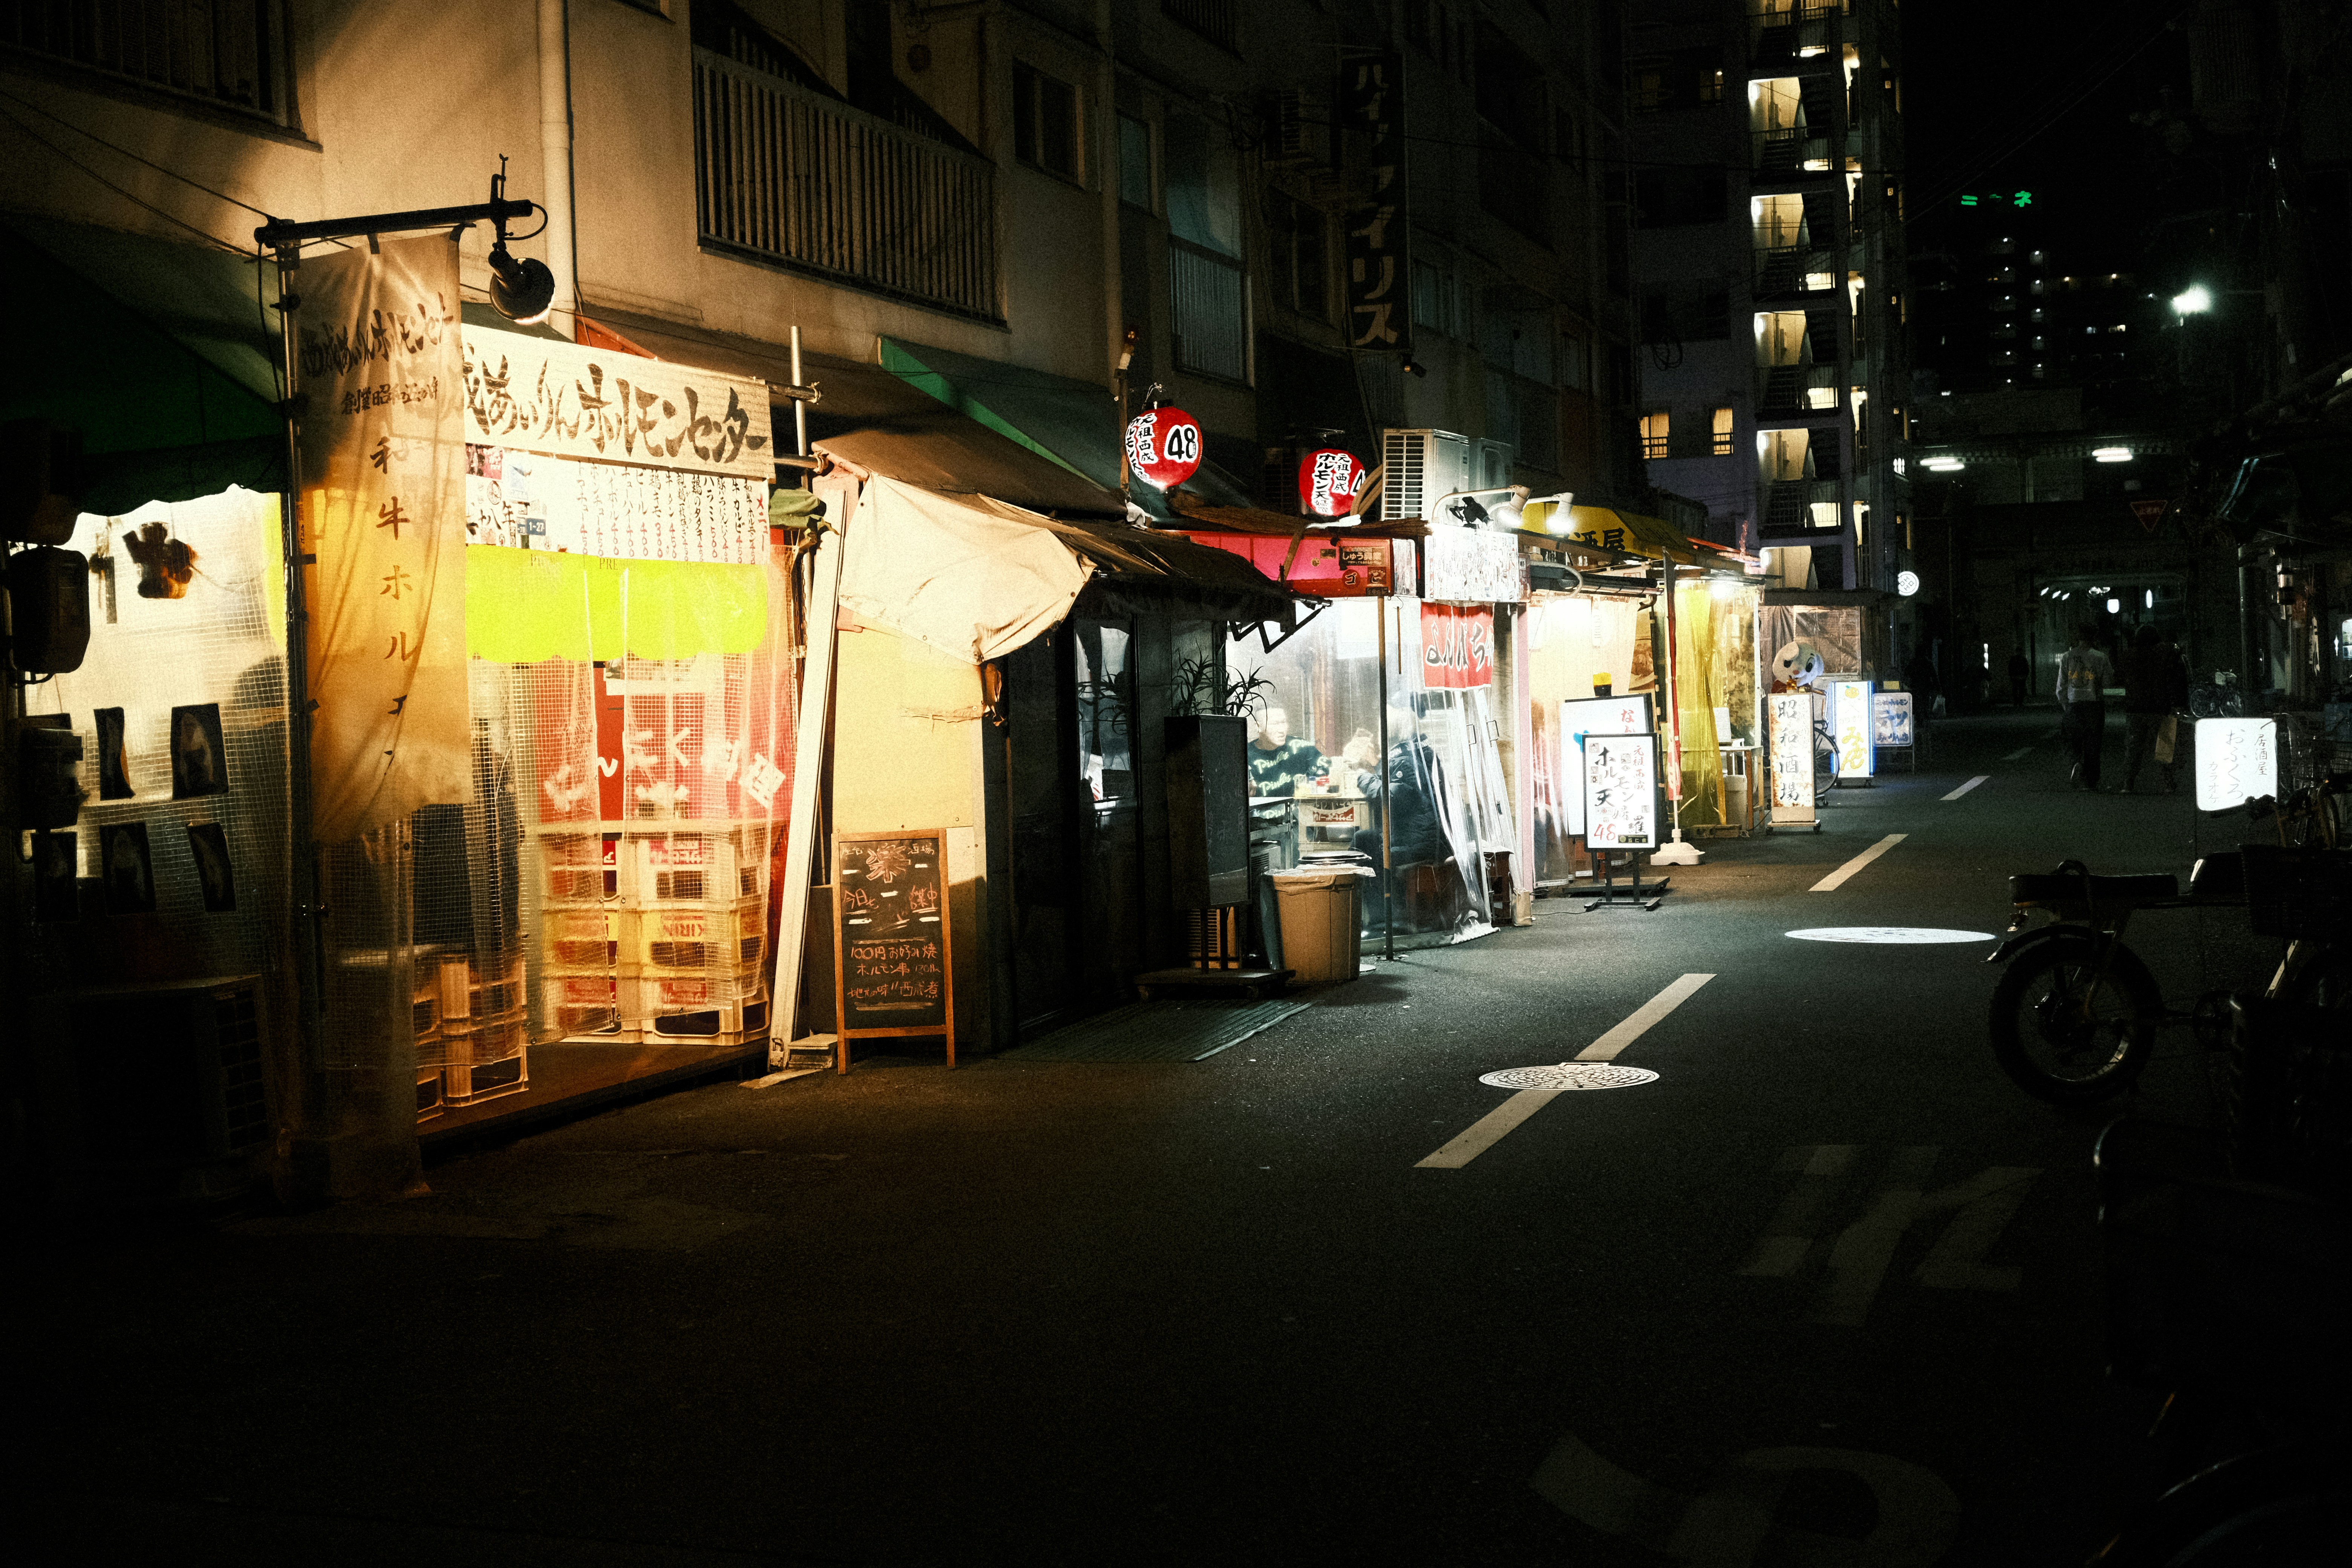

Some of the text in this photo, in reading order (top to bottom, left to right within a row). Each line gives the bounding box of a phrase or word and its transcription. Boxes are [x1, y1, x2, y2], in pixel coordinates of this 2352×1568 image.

[1138, 413, 1155, 461] 元祖西成
[1168, 427, 1197, 459] 48
[1334, 455, 1350, 492] 元祖西成
[576, 460, 589, 555] トマチュー 450
[606, 467, 619, 556] ハイボール 400
[622, 466, 635, 557] チューハイ 400
[636, 468, 649, 556] ビール 400
[665, 471, 677, 559] 牛タン 450
[704, 476, 715, 522] ハラミ
[732, 478, 745, 534] 牛カルビ
[529, 521, 544, 532] 1-27
[655, 522, 663, 558] 300
[756, 494, 768, 552] メニュー
[1633, 745, 1645, 791] 元祖西成
[1778, 699, 1800, 801] 昭和酒場
[2223, 729, 2247, 799] おふくろ
[2254, 734, 2268, 775] 居酒屋
[1594, 746, 1634, 802] ホルモン
[2208, 761, 2219, 804] カラオケ
[907, 842, 935, 855] 酒場
[1594, 823, 1616, 841] 48
[843, 888, 879, 910] 今日も
